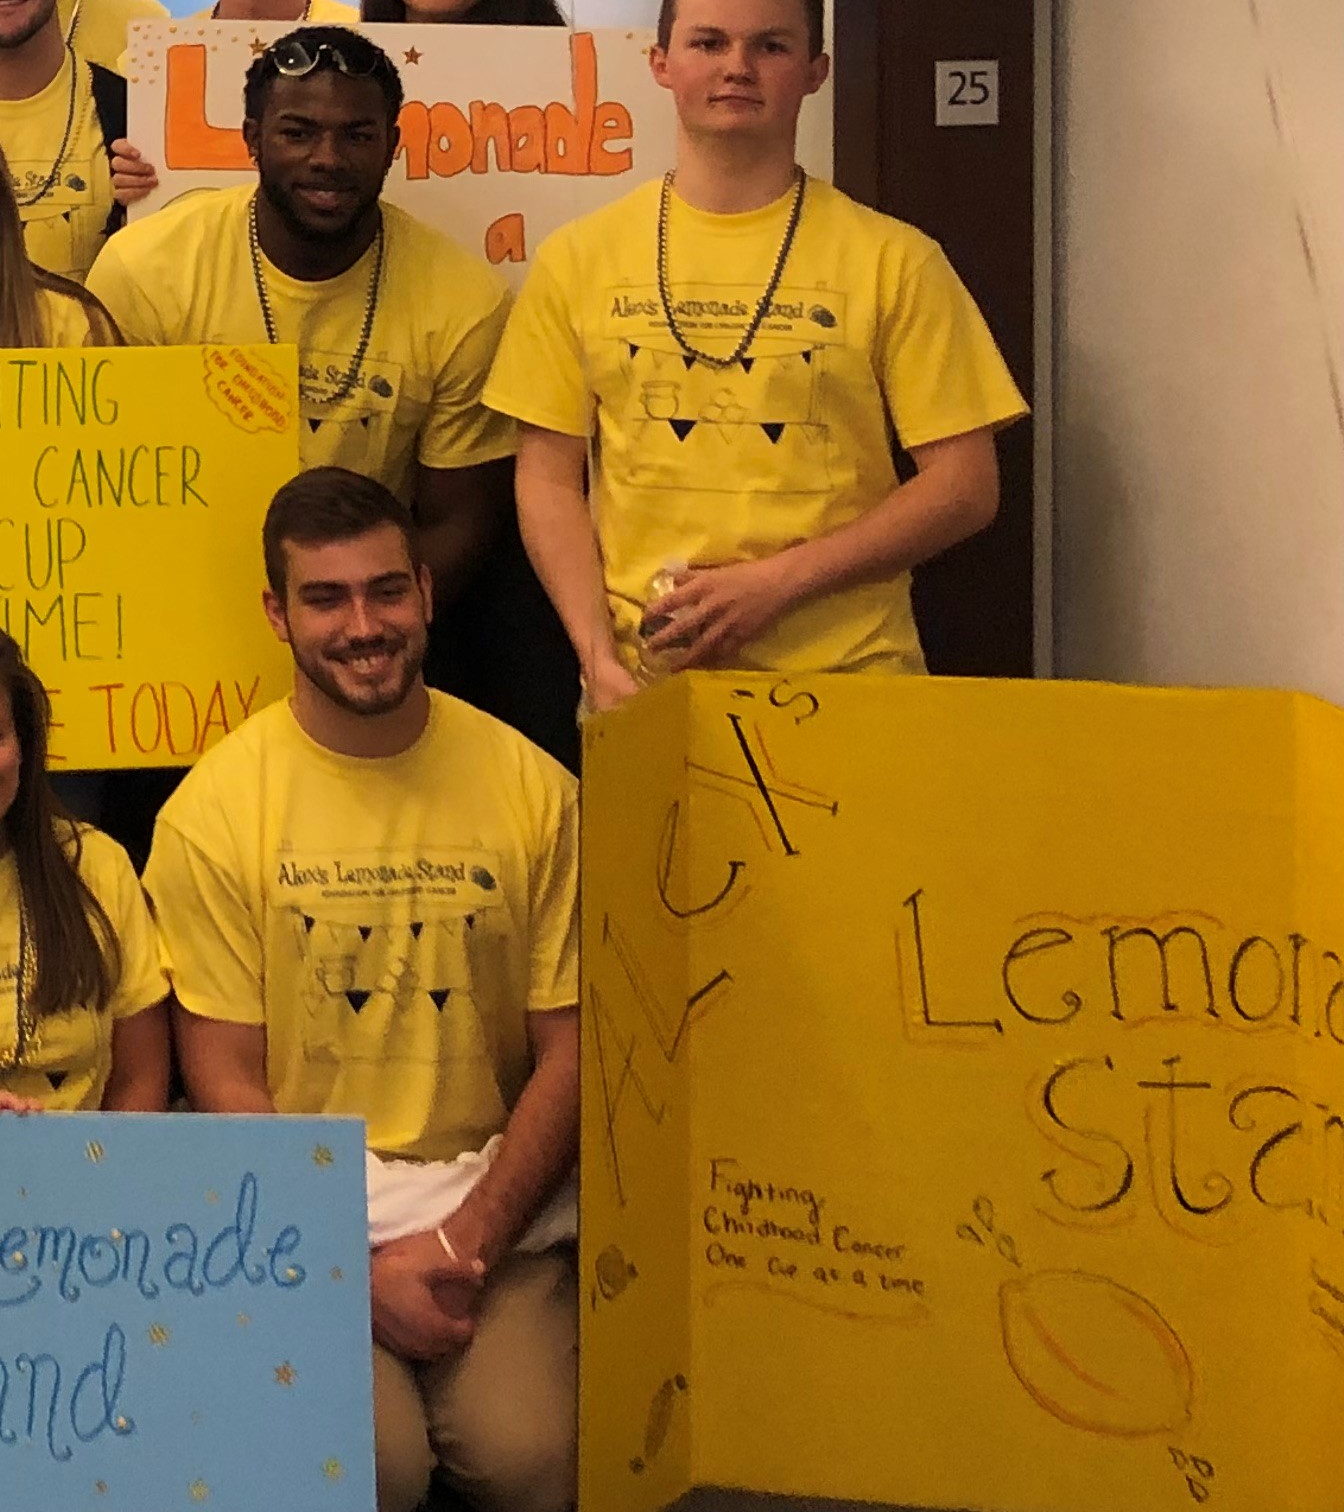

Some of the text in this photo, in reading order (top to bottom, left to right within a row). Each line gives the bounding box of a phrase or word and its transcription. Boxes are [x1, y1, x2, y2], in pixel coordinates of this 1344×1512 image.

[164, 31, 635, 180] Lmonade
[947, 70, 991, 106] 25
[484, 212, 527, 264] a
[668, 297, 749, 318] emonade
[32, 444, 209, 508] CANCER
[89, 675, 262, 757] TODAY
[705, 1241, 748, 1269] One
[832, 1224, 906, 1261] Cancer
